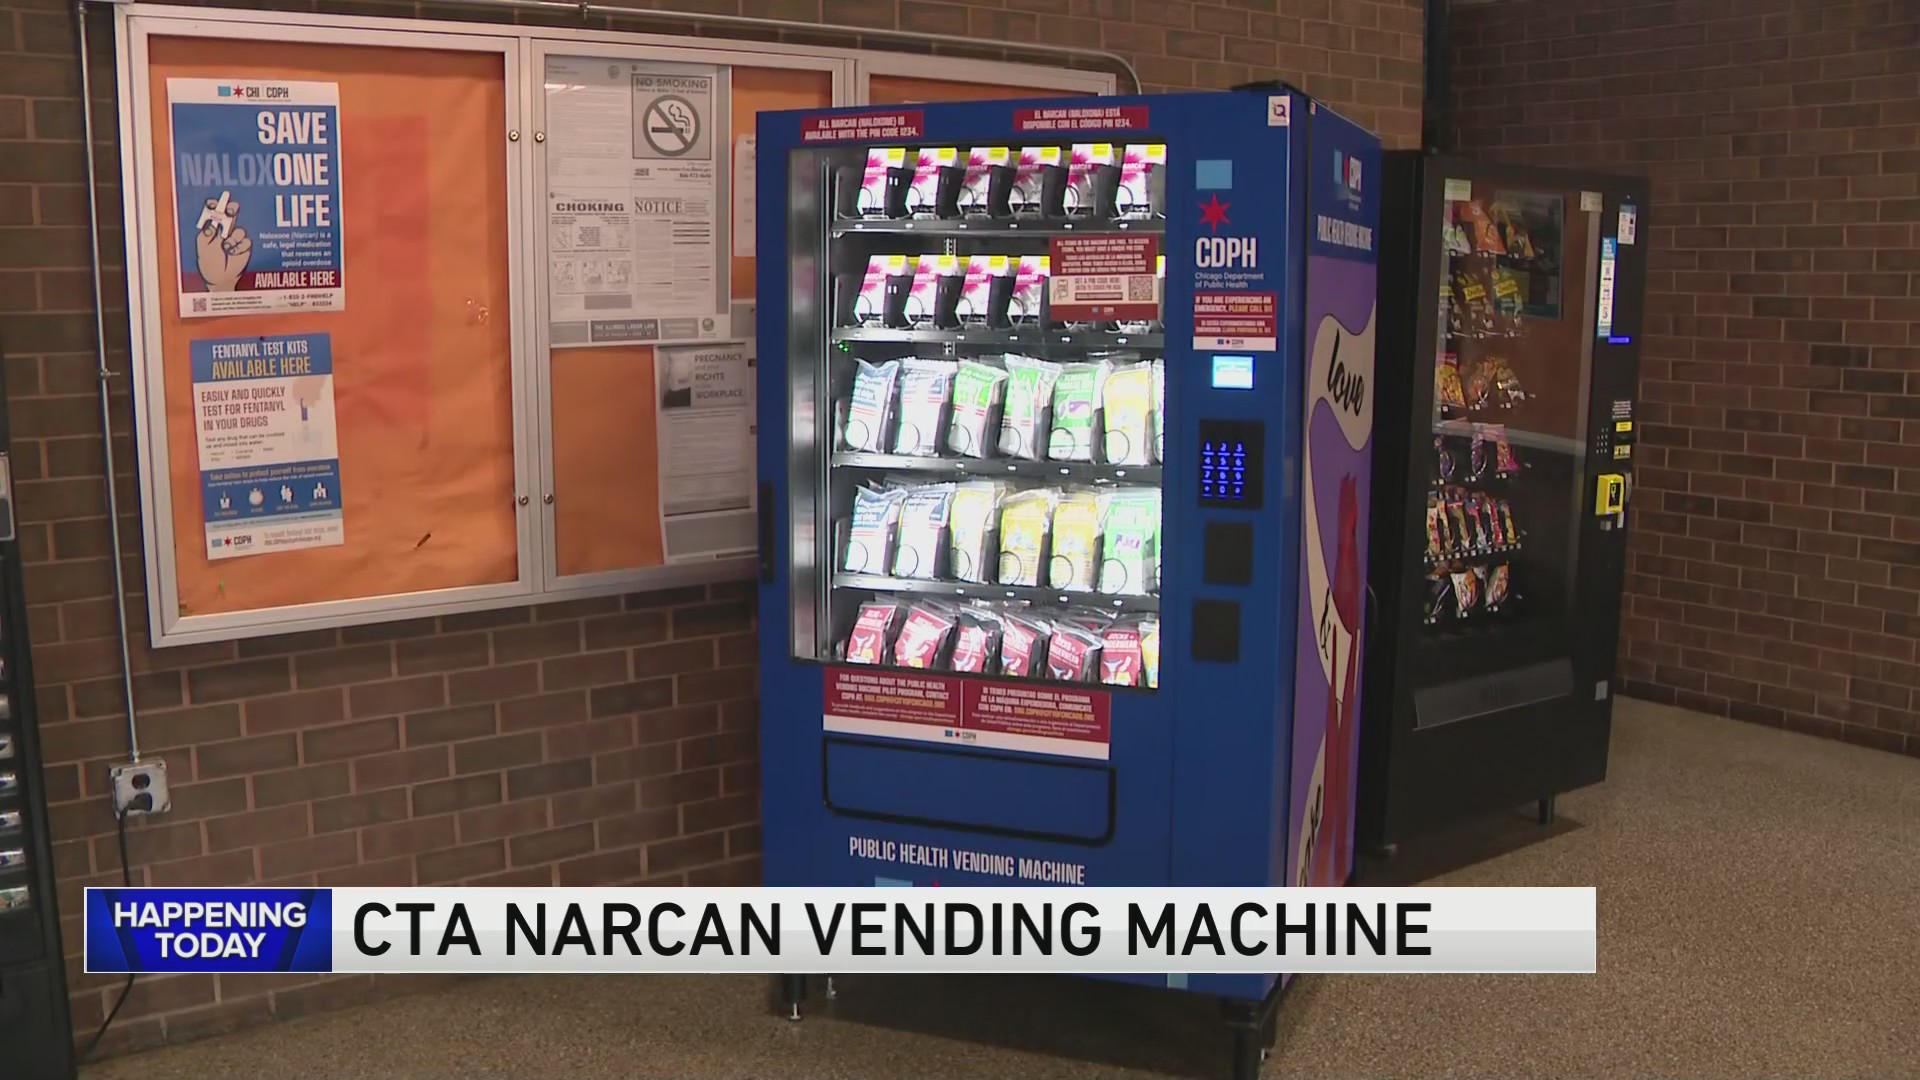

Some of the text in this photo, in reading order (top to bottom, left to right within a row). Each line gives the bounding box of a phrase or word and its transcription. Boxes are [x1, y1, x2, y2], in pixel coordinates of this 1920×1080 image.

[636, 77, 708, 89] NO SMOKING
[246, 86, 260, 98] CHI
[1034, 110, 1042, 118] EL
[1043, 109, 1067, 118] NARCAN
[257, 111, 328, 144] SAVE
[818, 120, 830, 129] ALL
[832, 118, 858, 128] NARCAN
[1058, 119, 1070, 128] CON
[1071, 119, 1078, 128] EL
[1103, 118, 1114, 128] PIN
[804, 130, 837, 140] AVAILABLE
[838, 130, 855, 139] WITH
[856, 129, 868, 138] THE
[870, 128, 880, 138] PIN
[882, 128, 898, 137] CODE
[276, 194, 330, 228] LIFE
[556, 203, 625, 212] CHOKING
[634, 200, 683, 214] NOTICE
[1195, 237, 1257, 268] CDPH
[282, 259, 302, 268] opioid
[255, 271, 335, 288] AVAILABLE HERE
[1195, 272, 1264, 281] Chicago Department
[212, 340, 308, 359] FENTANYL TEST KITS
[694, 352, 743, 363] PREGNANCY
[212, 356, 312, 380] AVAILABLE HERE
[1328, 328, 1364, 417] love
[695, 372, 725, 381] RIGHTS
[202, 386, 286, 402] EASILY AND QUICKLY
[696, 388, 743, 399] WORKPLACE
[202, 400, 286, 417] TEST FOR FENTANYL
[204, 416, 268, 431] IN YOUR DRUGS
[907, 679, 926, 688] PUBLIC
[849, 836, 1086, 886] PUBLIC HEALTH VENDING MACHINE
